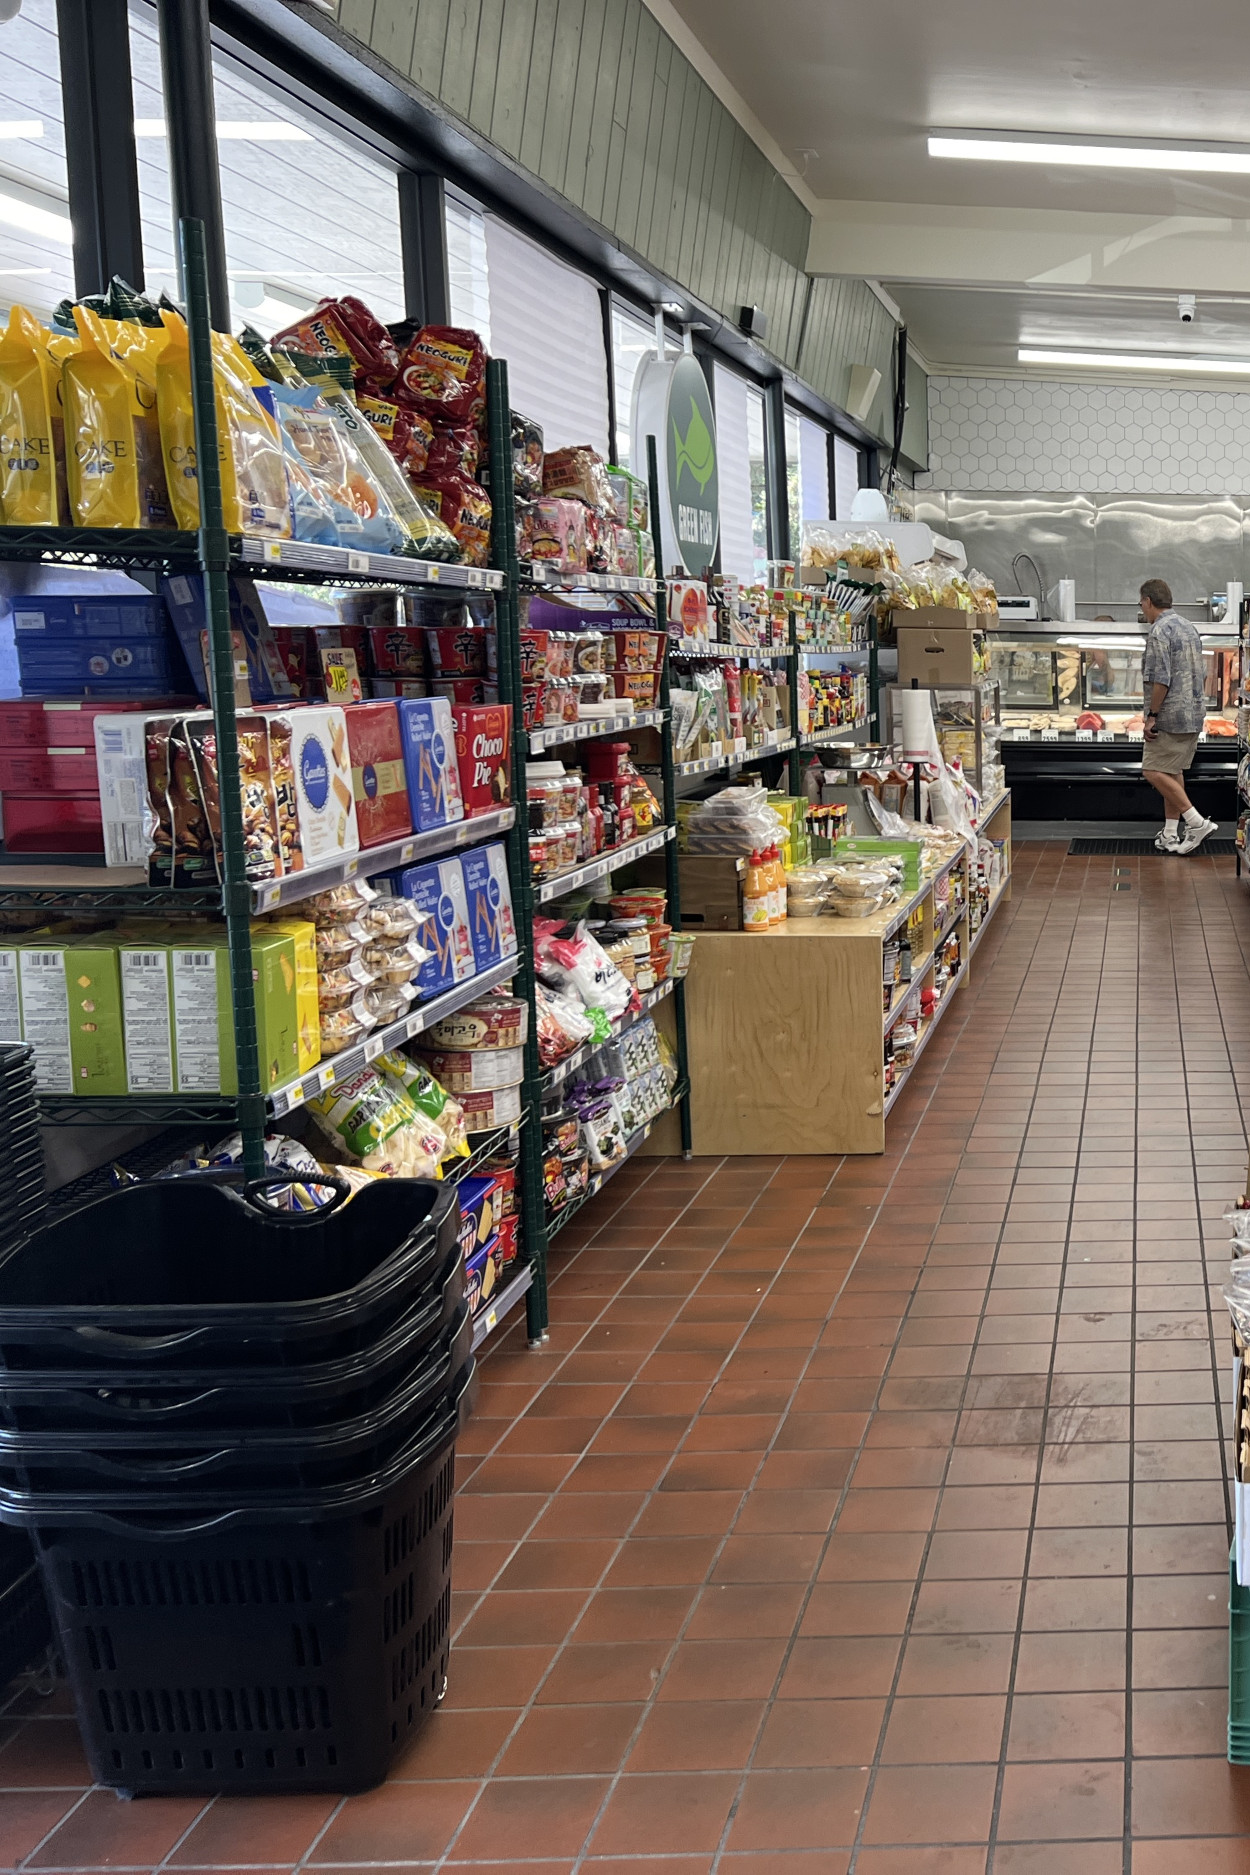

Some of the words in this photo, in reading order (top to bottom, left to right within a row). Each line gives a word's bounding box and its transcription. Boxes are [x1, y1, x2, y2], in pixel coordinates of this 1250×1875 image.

[417, 343, 468, 367] NEOGURI
[74, 439, 127, 458] CAKE
[679, 503, 698, 543] GREEN
[699, 509, 713, 546] FISH
[612, 618, 629, 627] SOUP
[629, 618, 647, 627] BOWL
[386, 631, 413, 666] 辛
[453, 630, 480, 666] 辛
[473, 733, 503, 759] Choco
[472, 761, 492, 788] Pie
[333, 1067, 380, 1099] Dand
